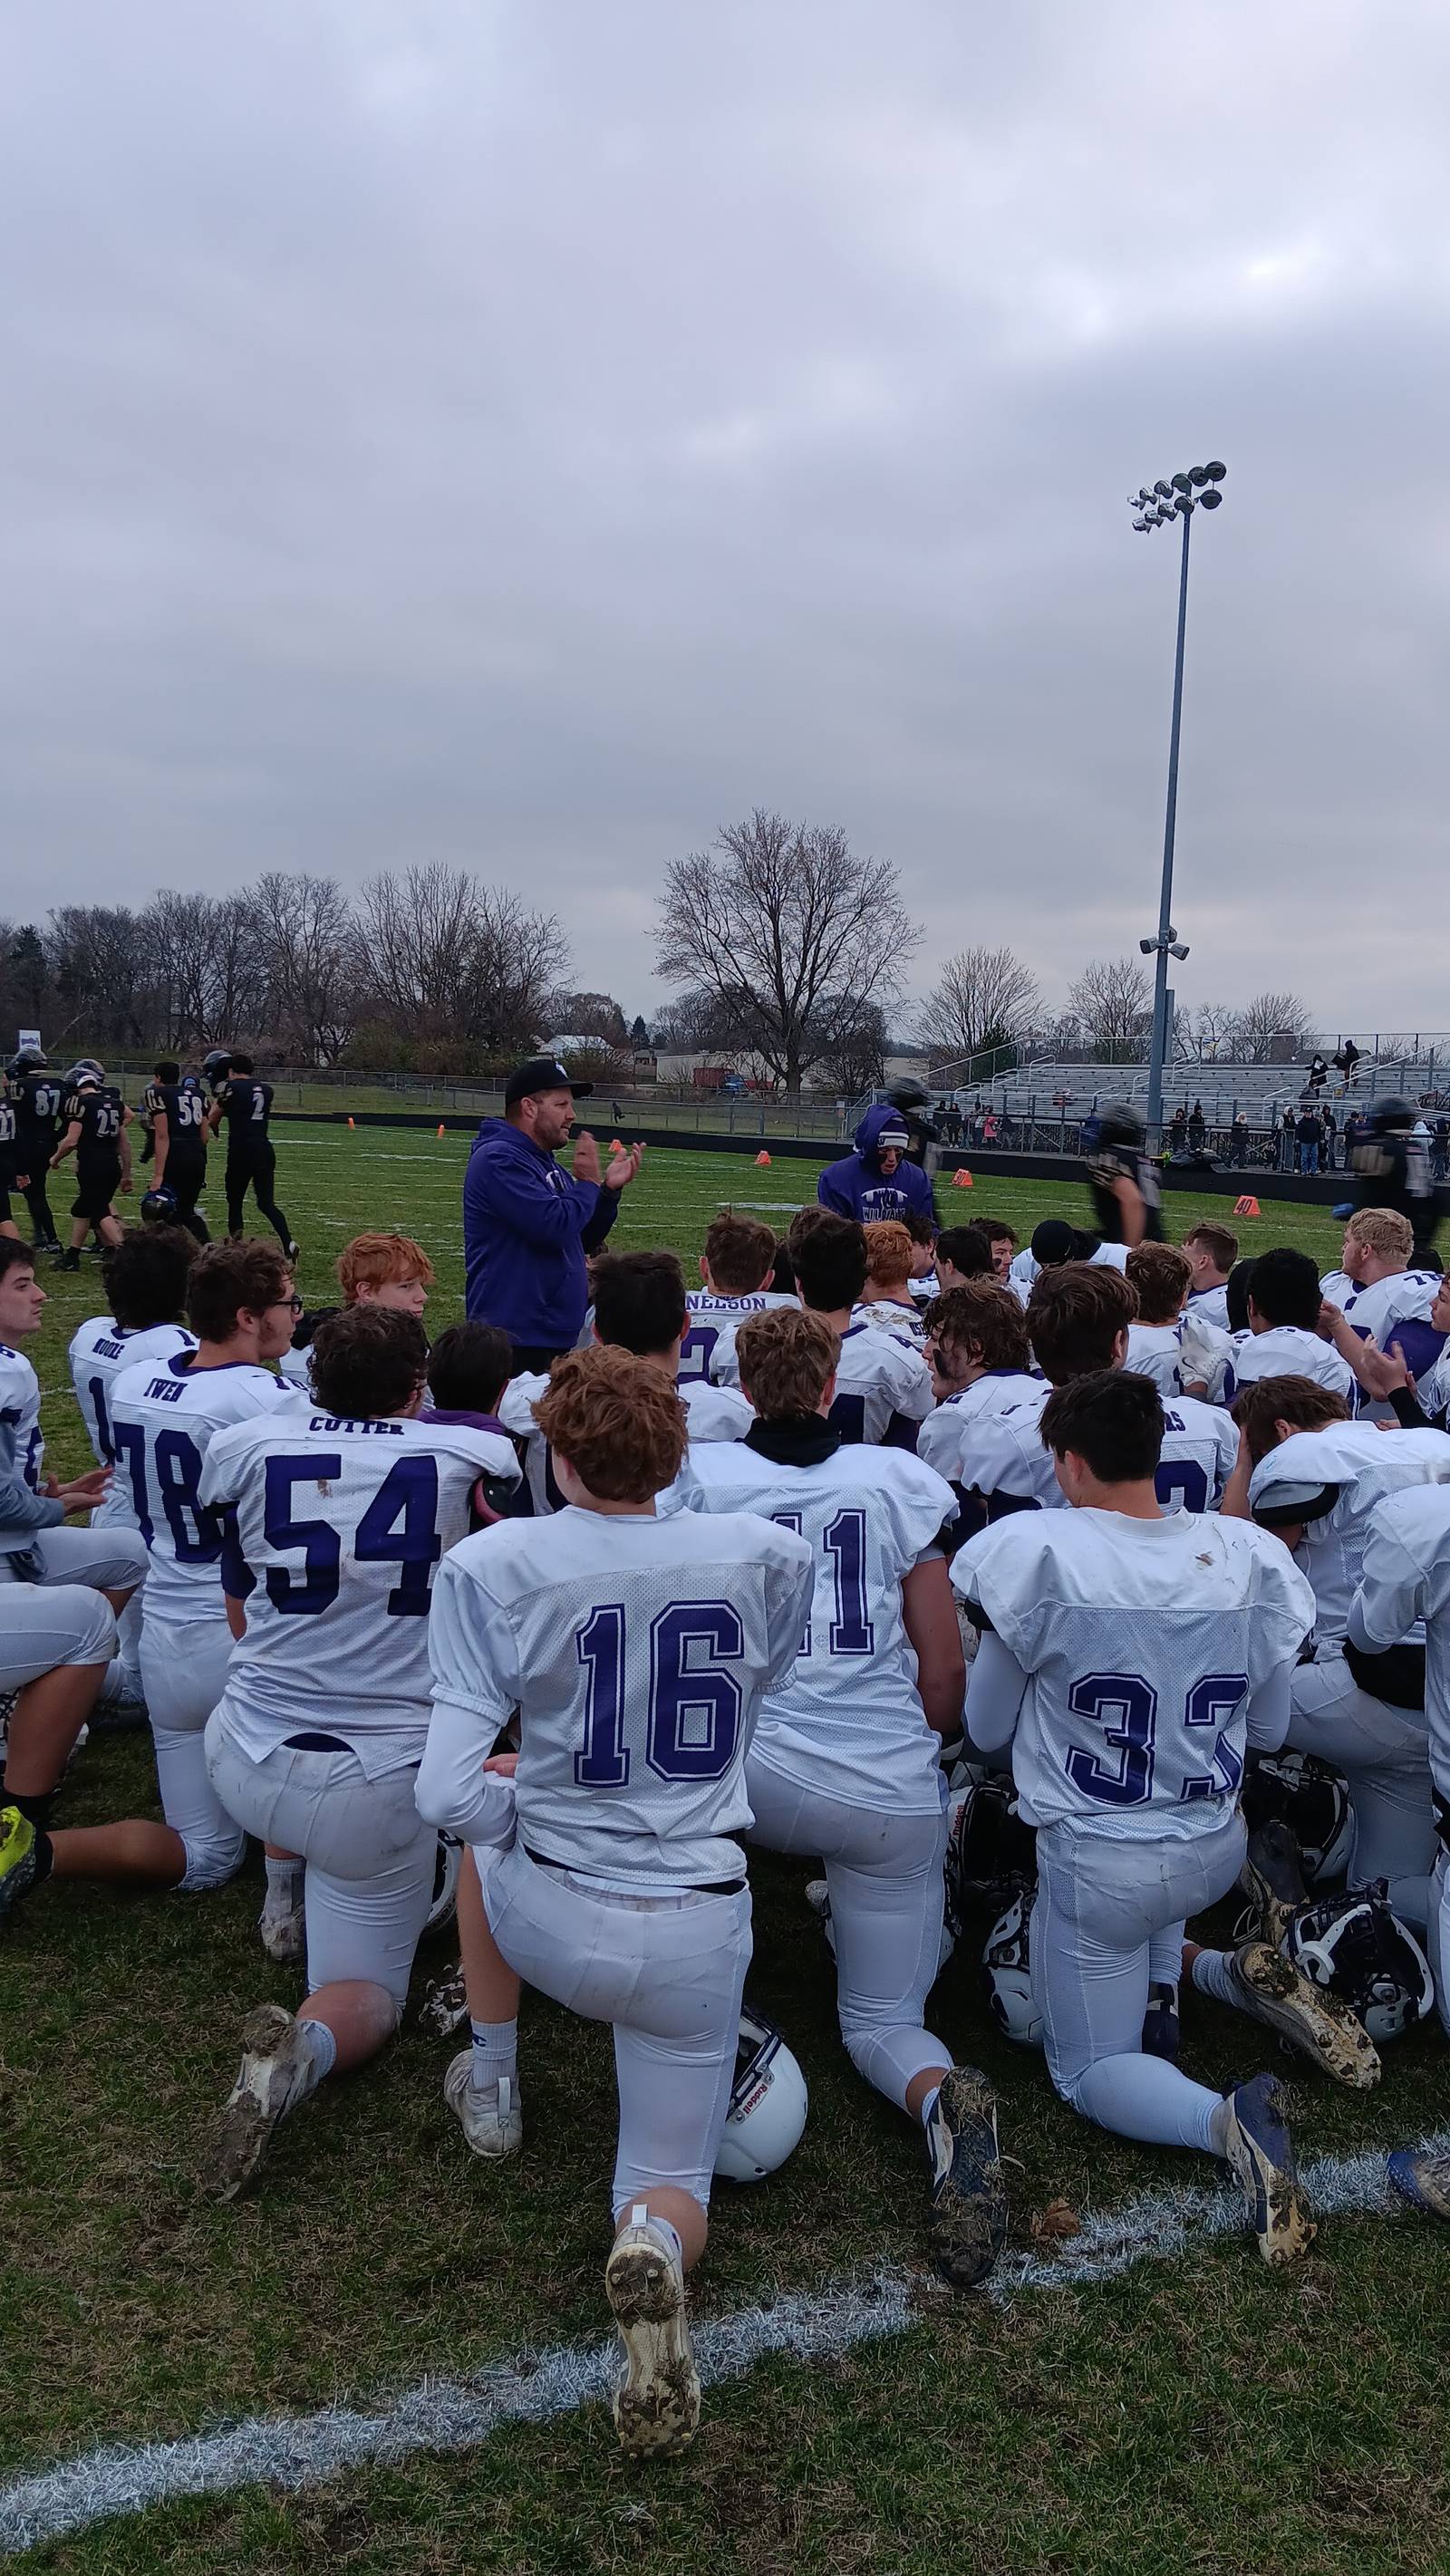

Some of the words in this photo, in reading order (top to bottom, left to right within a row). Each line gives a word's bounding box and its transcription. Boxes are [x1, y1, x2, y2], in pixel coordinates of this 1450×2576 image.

[35, 1089, 61, 1116] 87
[178, 1095, 203, 1125] 58
[251, 1092, 265, 1120] 2
[96, 1108, 120, 1137] 25
[1236, 1198, 1252, 1215] 40
[686, 1295, 767, 1311] NELSON
[309, 1416, 404, 1435] CUTTER
[112, 1421, 223, 1563] 78
[265, 1453, 441, 1616] 54
[574, 1599, 745, 1788] 16
[742, 2083, 768, 2115] Riddell
